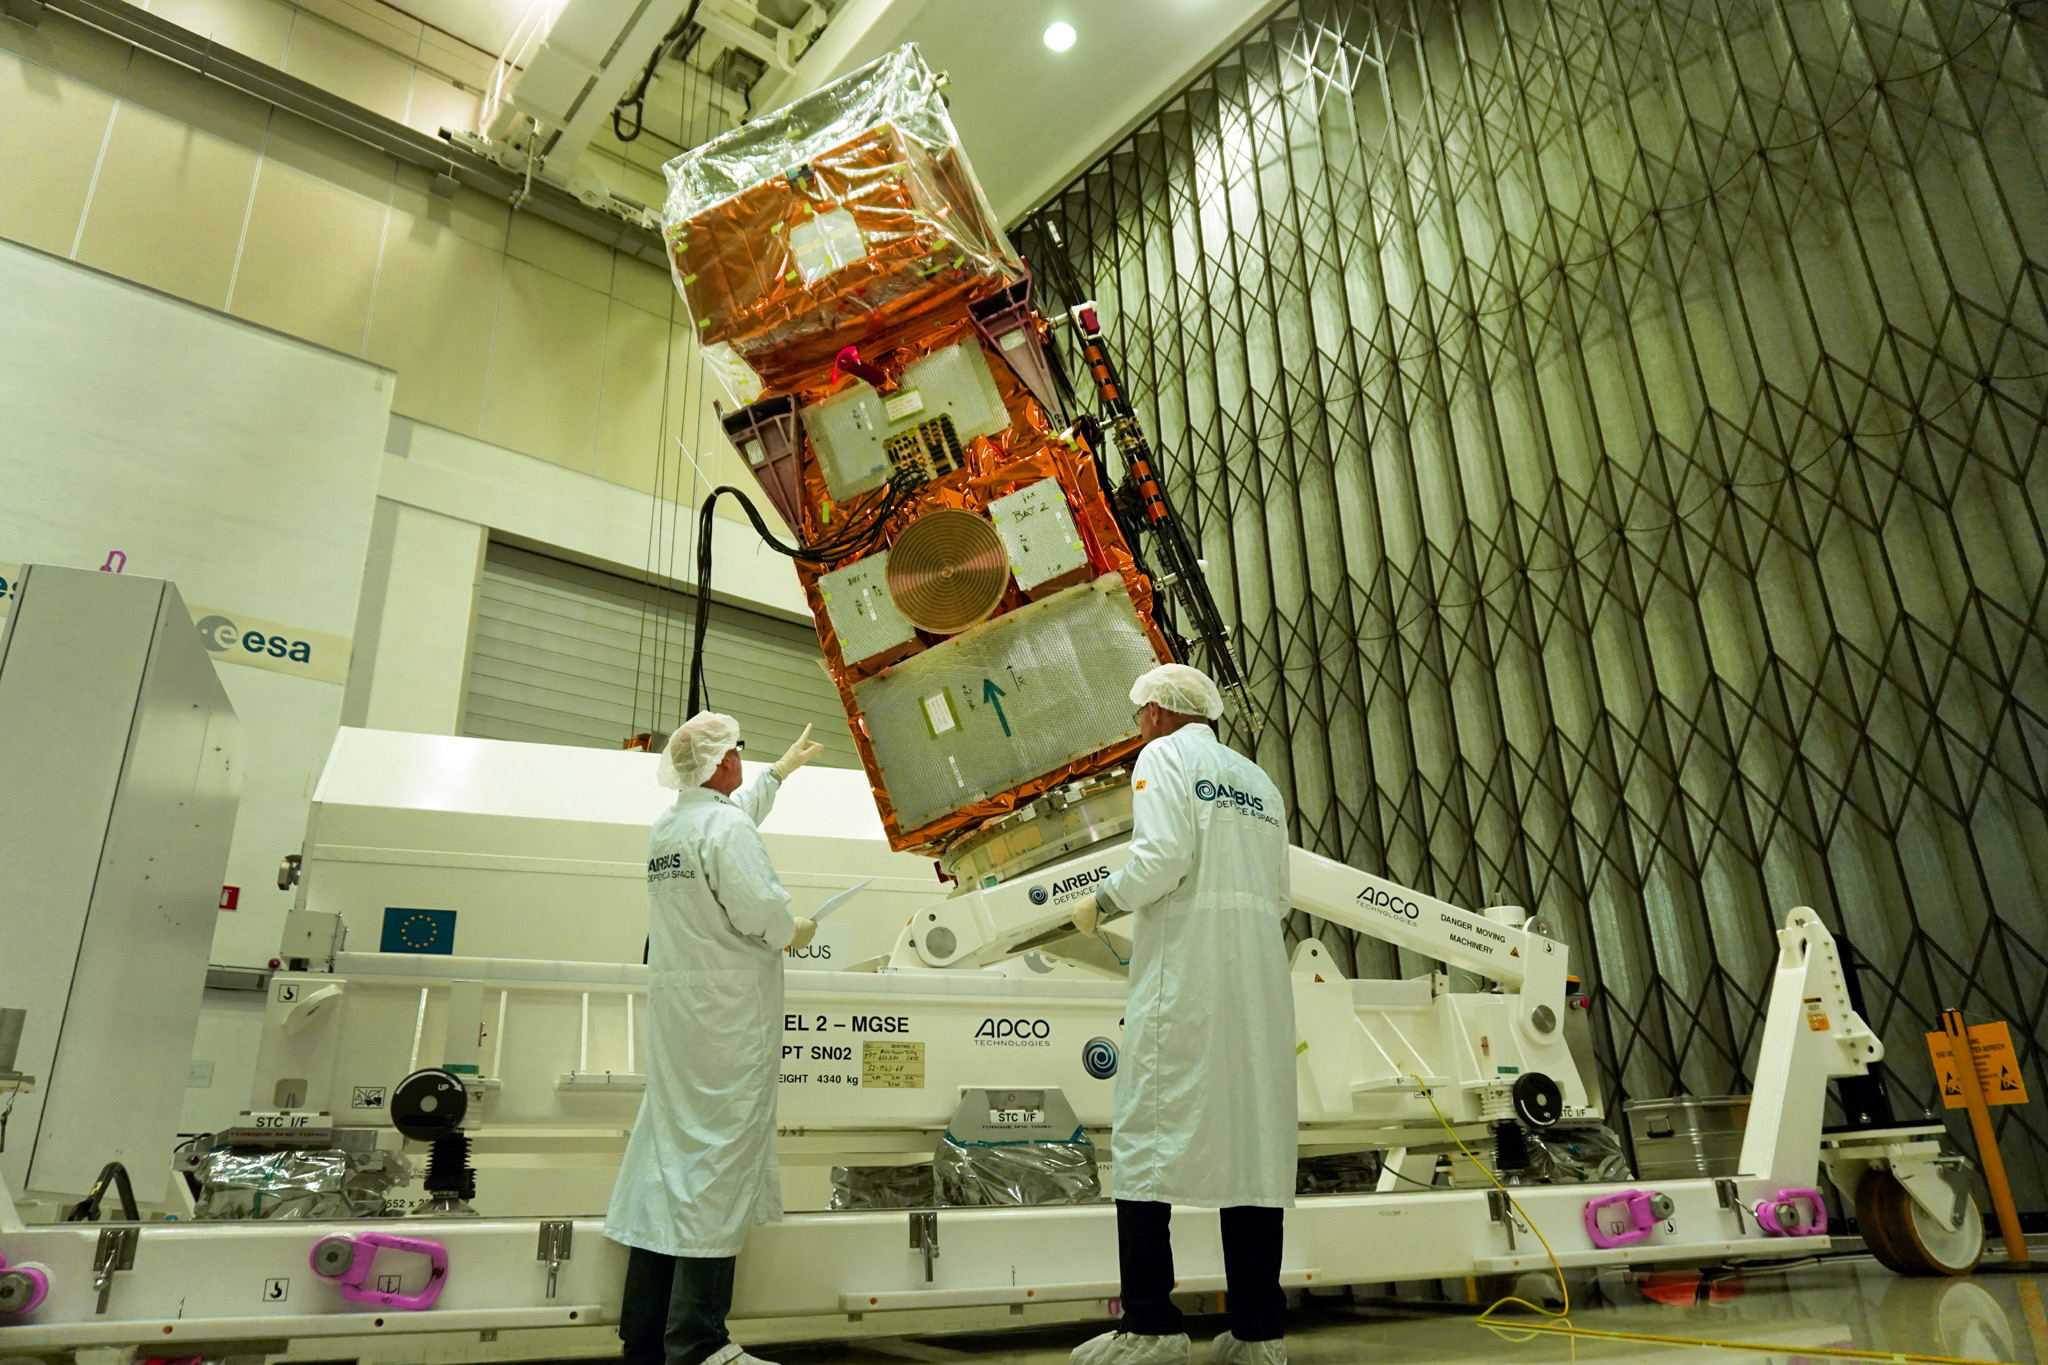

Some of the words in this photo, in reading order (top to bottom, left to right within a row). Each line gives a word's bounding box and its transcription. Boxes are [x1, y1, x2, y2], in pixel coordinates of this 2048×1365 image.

[242, 631, 311, 664] esa
[1052, 865, 1111, 897] AIRBUS
[1053, 885, 1096, 906] DEFENCE
[1357, 886, 1420, 920] APCO
[1356, 899, 1418, 928] TECHNOLOGIES
[1440, 913, 1473, 932] DANGER
[1476, 926, 1506, 944] MOVING
[1449, 933, 1494, 955] MACHINERY
[816, 1015, 828, 1031] 2
[851, 1015, 909, 1033] MGSE
[974, 1018, 1050, 1039] APCO
[811, 1046, 852, 1060] SN02
[974, 1039, 1051, 1047] TECHNOLOGIES
[437, 1083, 449, 1091] UP
[817, 1075, 842, 1084] 4340
[846, 1075, 859, 1087] kg
[256, 1117, 283, 1128] STC
[290, 1117, 309, 1128] I/F
[998, 1113, 1019, 1122] STC
[1023, 1113, 1037, 1122] I/F
